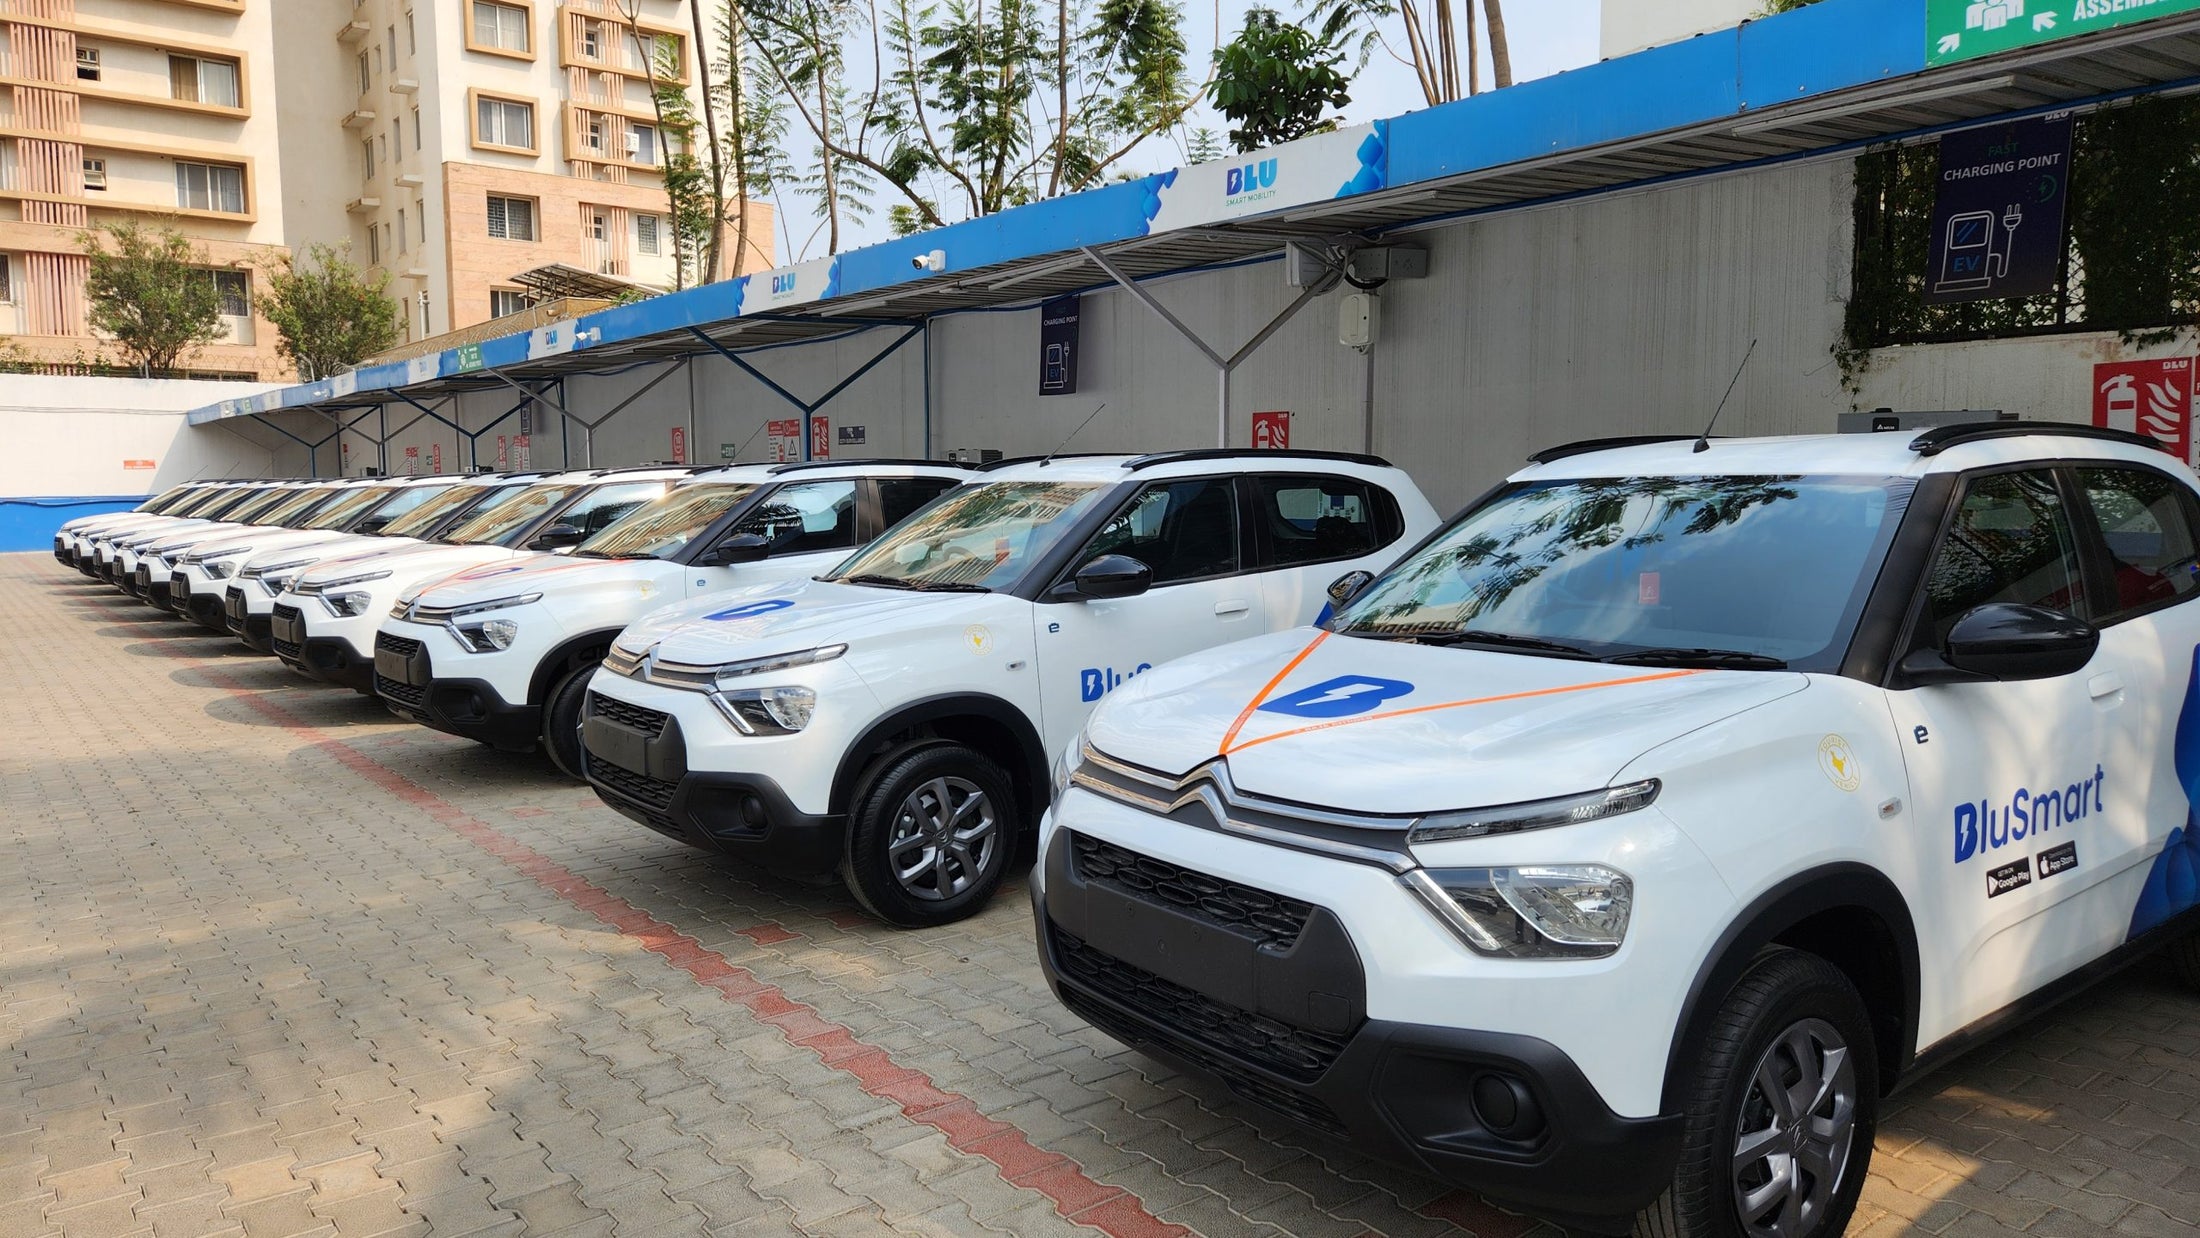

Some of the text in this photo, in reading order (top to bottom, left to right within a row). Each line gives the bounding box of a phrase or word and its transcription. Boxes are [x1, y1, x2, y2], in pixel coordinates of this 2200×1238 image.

[1944, 153, 2061, 181] CHARGING POINT
[1227, 158, 1277, 196] BLU
[1226, 190, 1276, 207] SMART MOBILITY
[1953, 254, 1981, 272] EV
[1044, 315, 1078, 326] CHARGING POINT
[2162, 360, 2188, 369] BLU
[1954, 763, 2104, 864] BluSmart
[2050, 855, 2075, 871] App Store
[1998, 870, 2029, 888] Google Play
